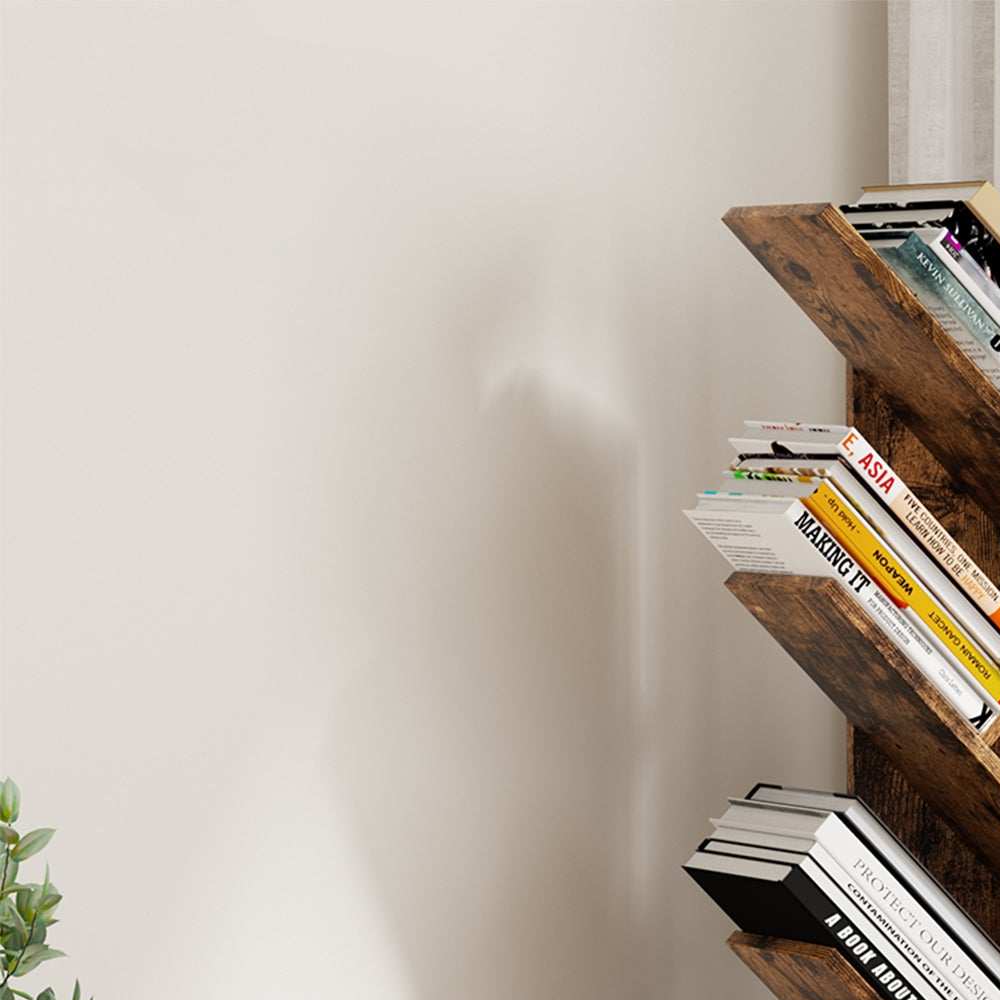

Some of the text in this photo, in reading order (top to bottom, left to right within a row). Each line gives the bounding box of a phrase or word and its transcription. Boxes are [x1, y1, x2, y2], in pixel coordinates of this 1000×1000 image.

[915, 251, 946, 285] KEVIN
[942, 282, 986, 331] SULLIVAN
[856, 450, 899, 494] ASIA
[825, 496, 857, 531] Hold Up
[904, 511, 930, 539] LEARN
[925, 535, 946, 556] HOW
[942, 552, 955, 566] TO
[950, 562, 965, 577] BE
[792, 510, 871, 594] MAKING IT
[870, 549, 915, 596] WEAPON
[902, 493, 922, 514] FIVE
[955, 553, 972, 570] ONE
[969, 568, 1000, 601] MISSION
[958, 644, 992, 680] ROMAIN
[823, 909, 842, 928] A
[835, 923, 877, 966] BOOK
[845, 881, 923, 963] CONTAMINATION
[920, 961, 935, 977] OF
[932, 975, 954, 997] THE
[851, 857, 922, 932] PROTECT
[915, 926, 955, 967] OUR
